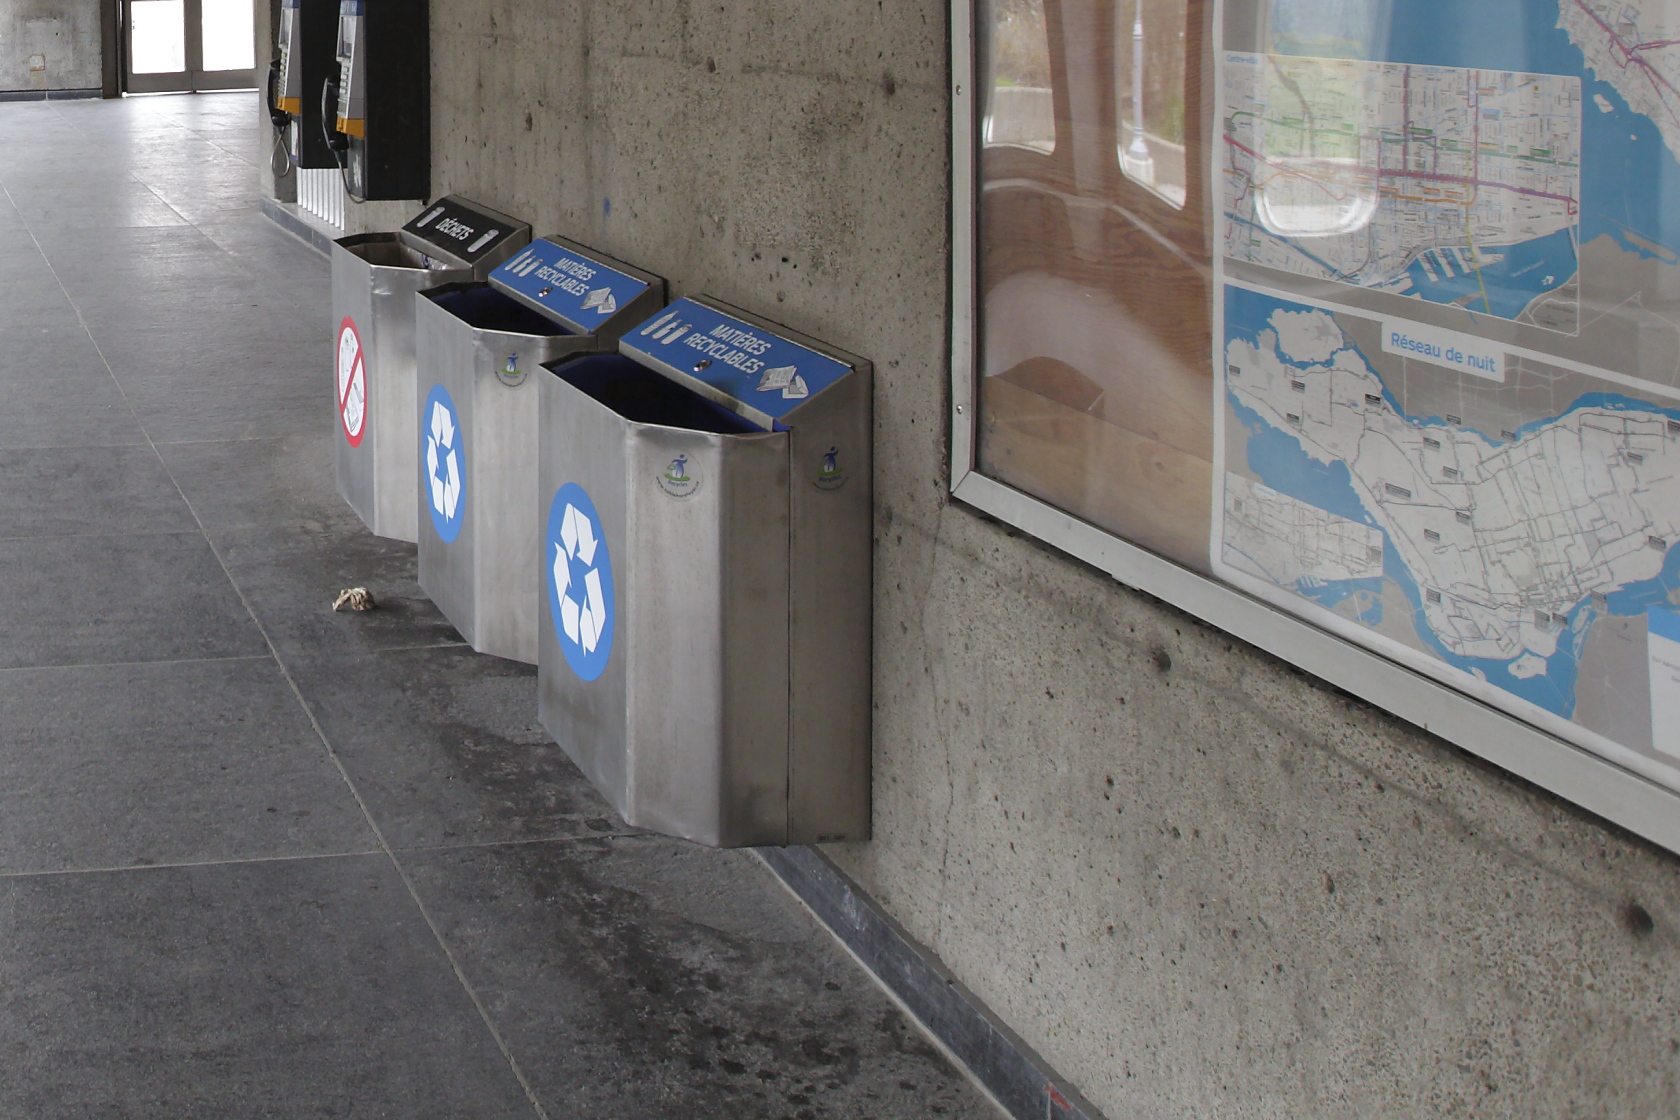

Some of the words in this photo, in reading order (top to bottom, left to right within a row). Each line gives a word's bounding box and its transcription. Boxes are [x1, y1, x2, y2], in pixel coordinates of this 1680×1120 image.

[435, 218, 474, 240] DÉCHETS
[534, 265, 590, 296] RECYCLABLES
[554, 257, 597, 281] MATIÈRES
[683, 332, 765, 374] RECYCLABLES
[709, 324, 772, 355] MATIÈRES
[1391, 332, 1441, 358] Réseau
[1445, 347, 1463, 364] de
[1467, 354, 1496, 373] nuit
